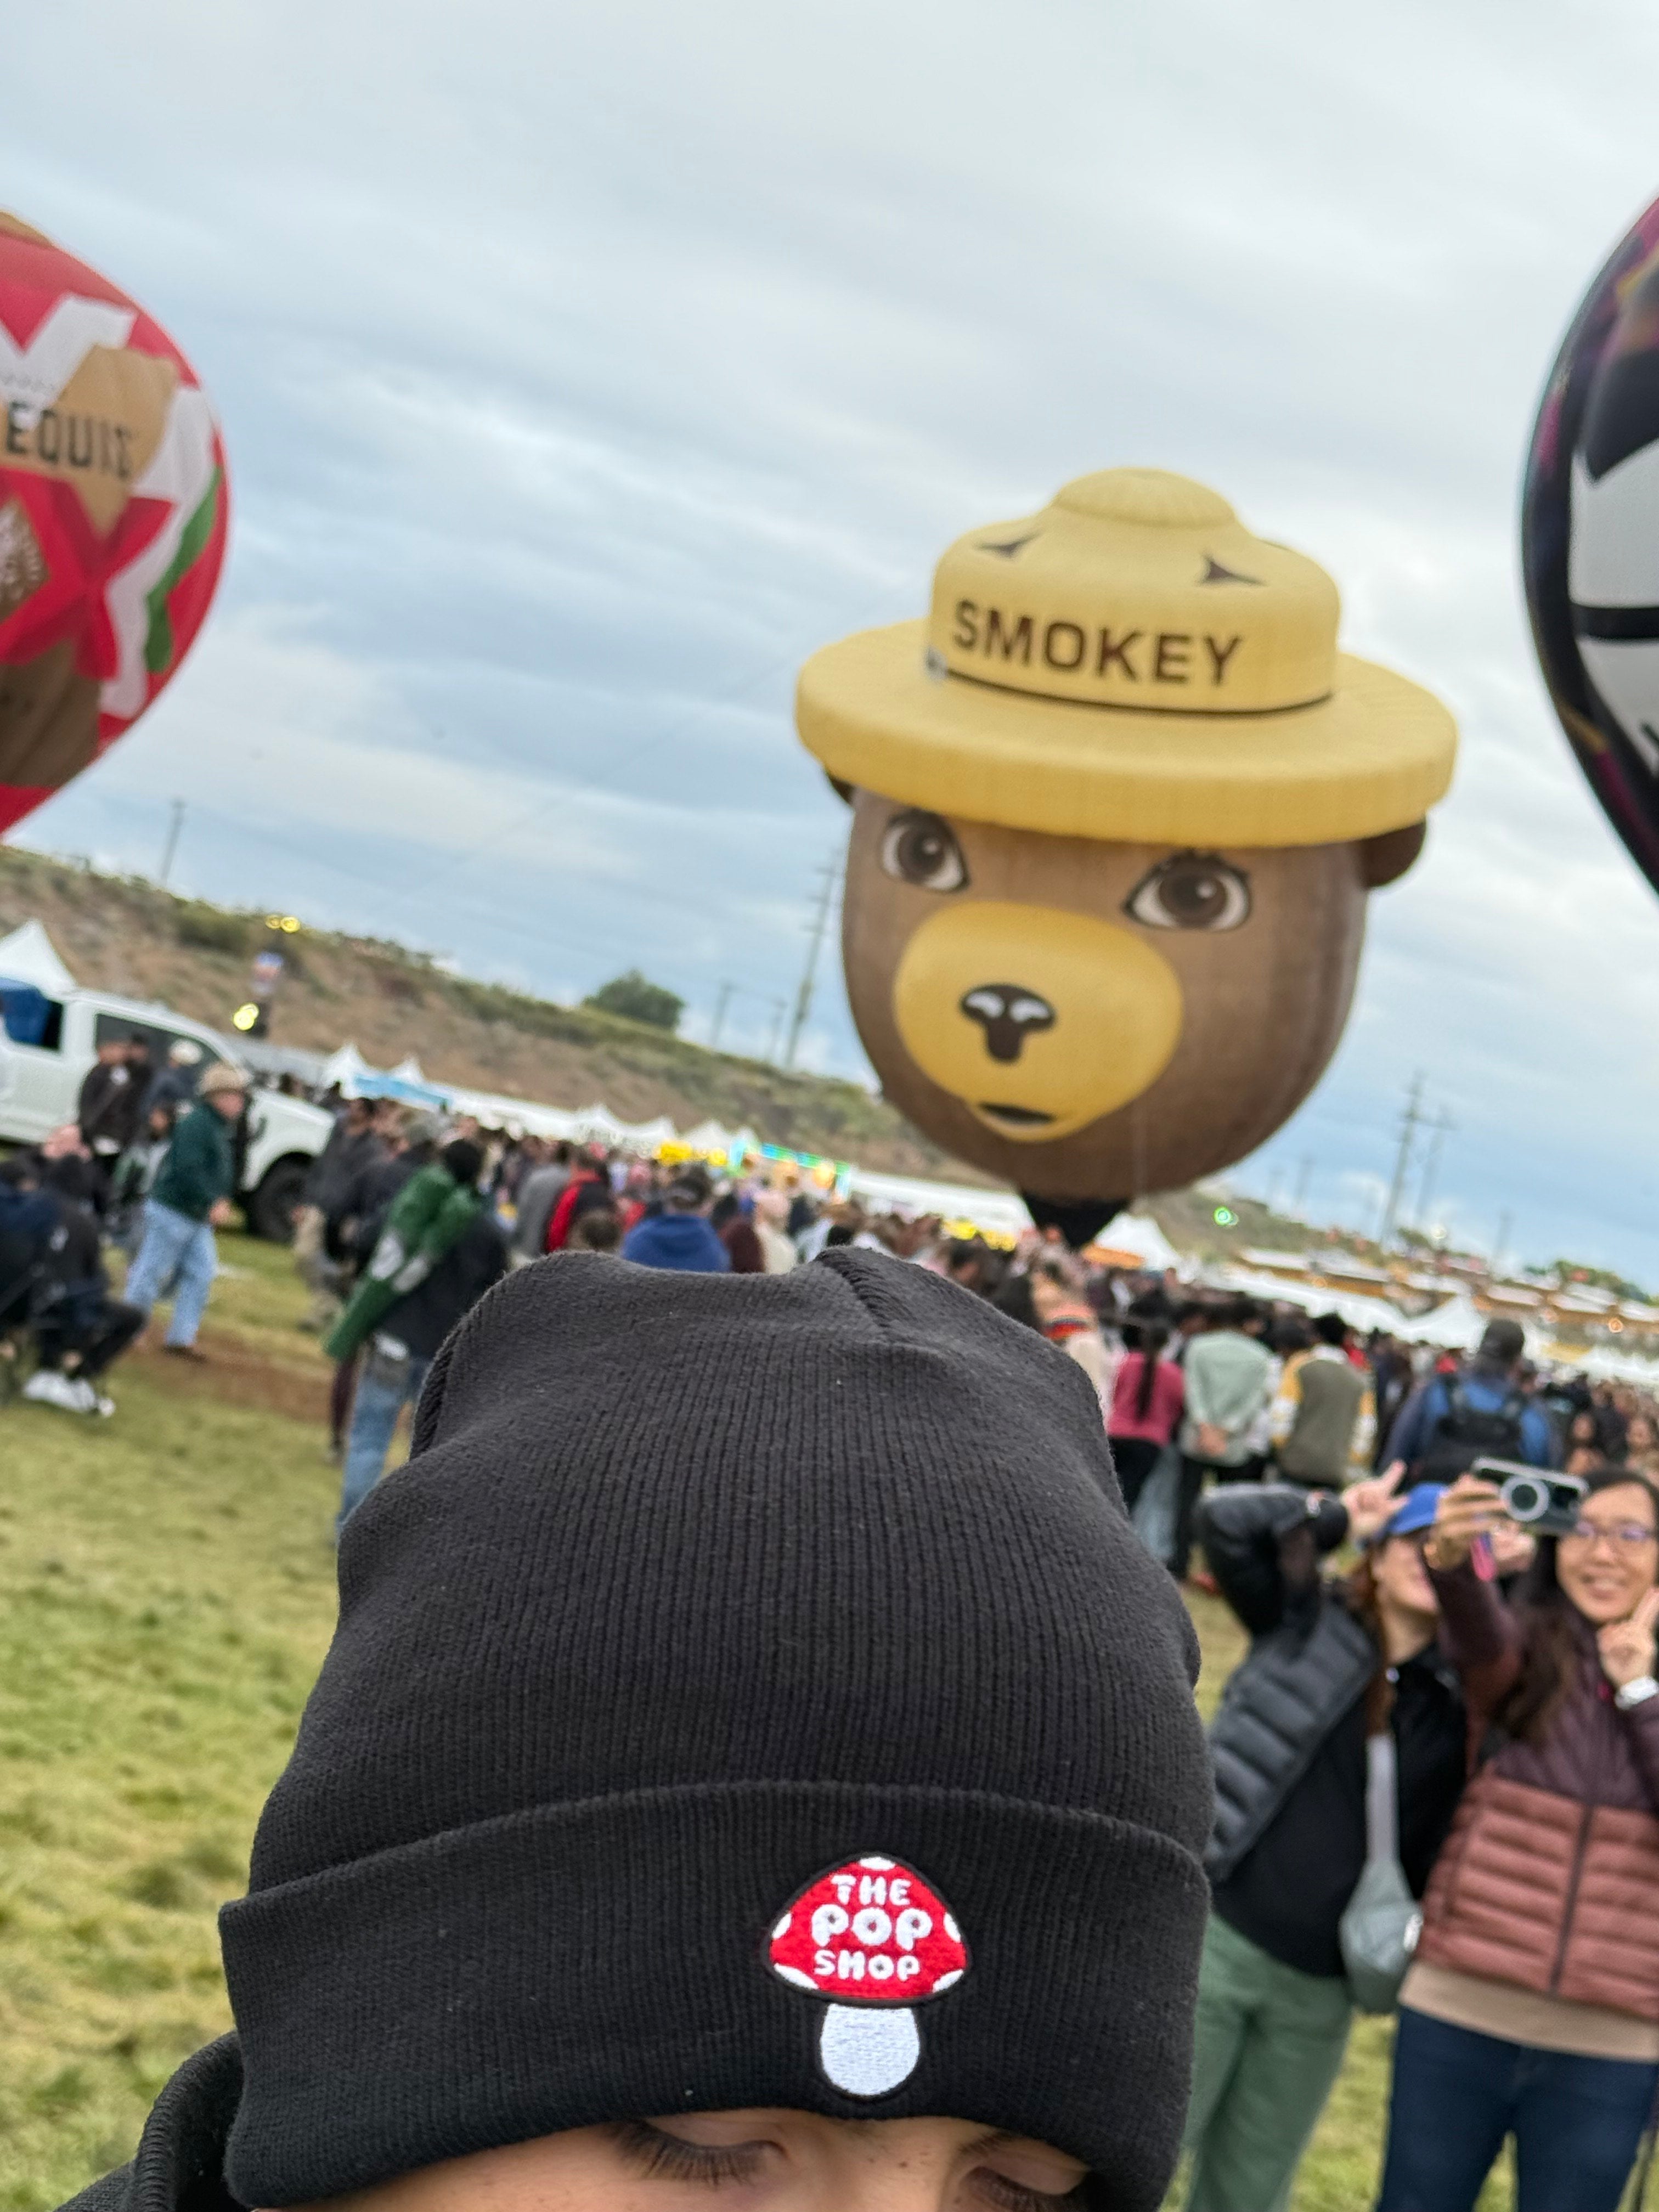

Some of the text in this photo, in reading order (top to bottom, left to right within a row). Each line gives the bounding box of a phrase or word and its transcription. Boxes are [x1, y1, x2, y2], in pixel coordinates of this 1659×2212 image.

[953, 599, 1243, 687] SMOKEY
[831, 1874, 911, 1905] THE
[811, 1904, 933, 1952] POP
[814, 1949, 921, 1982] SHOP
